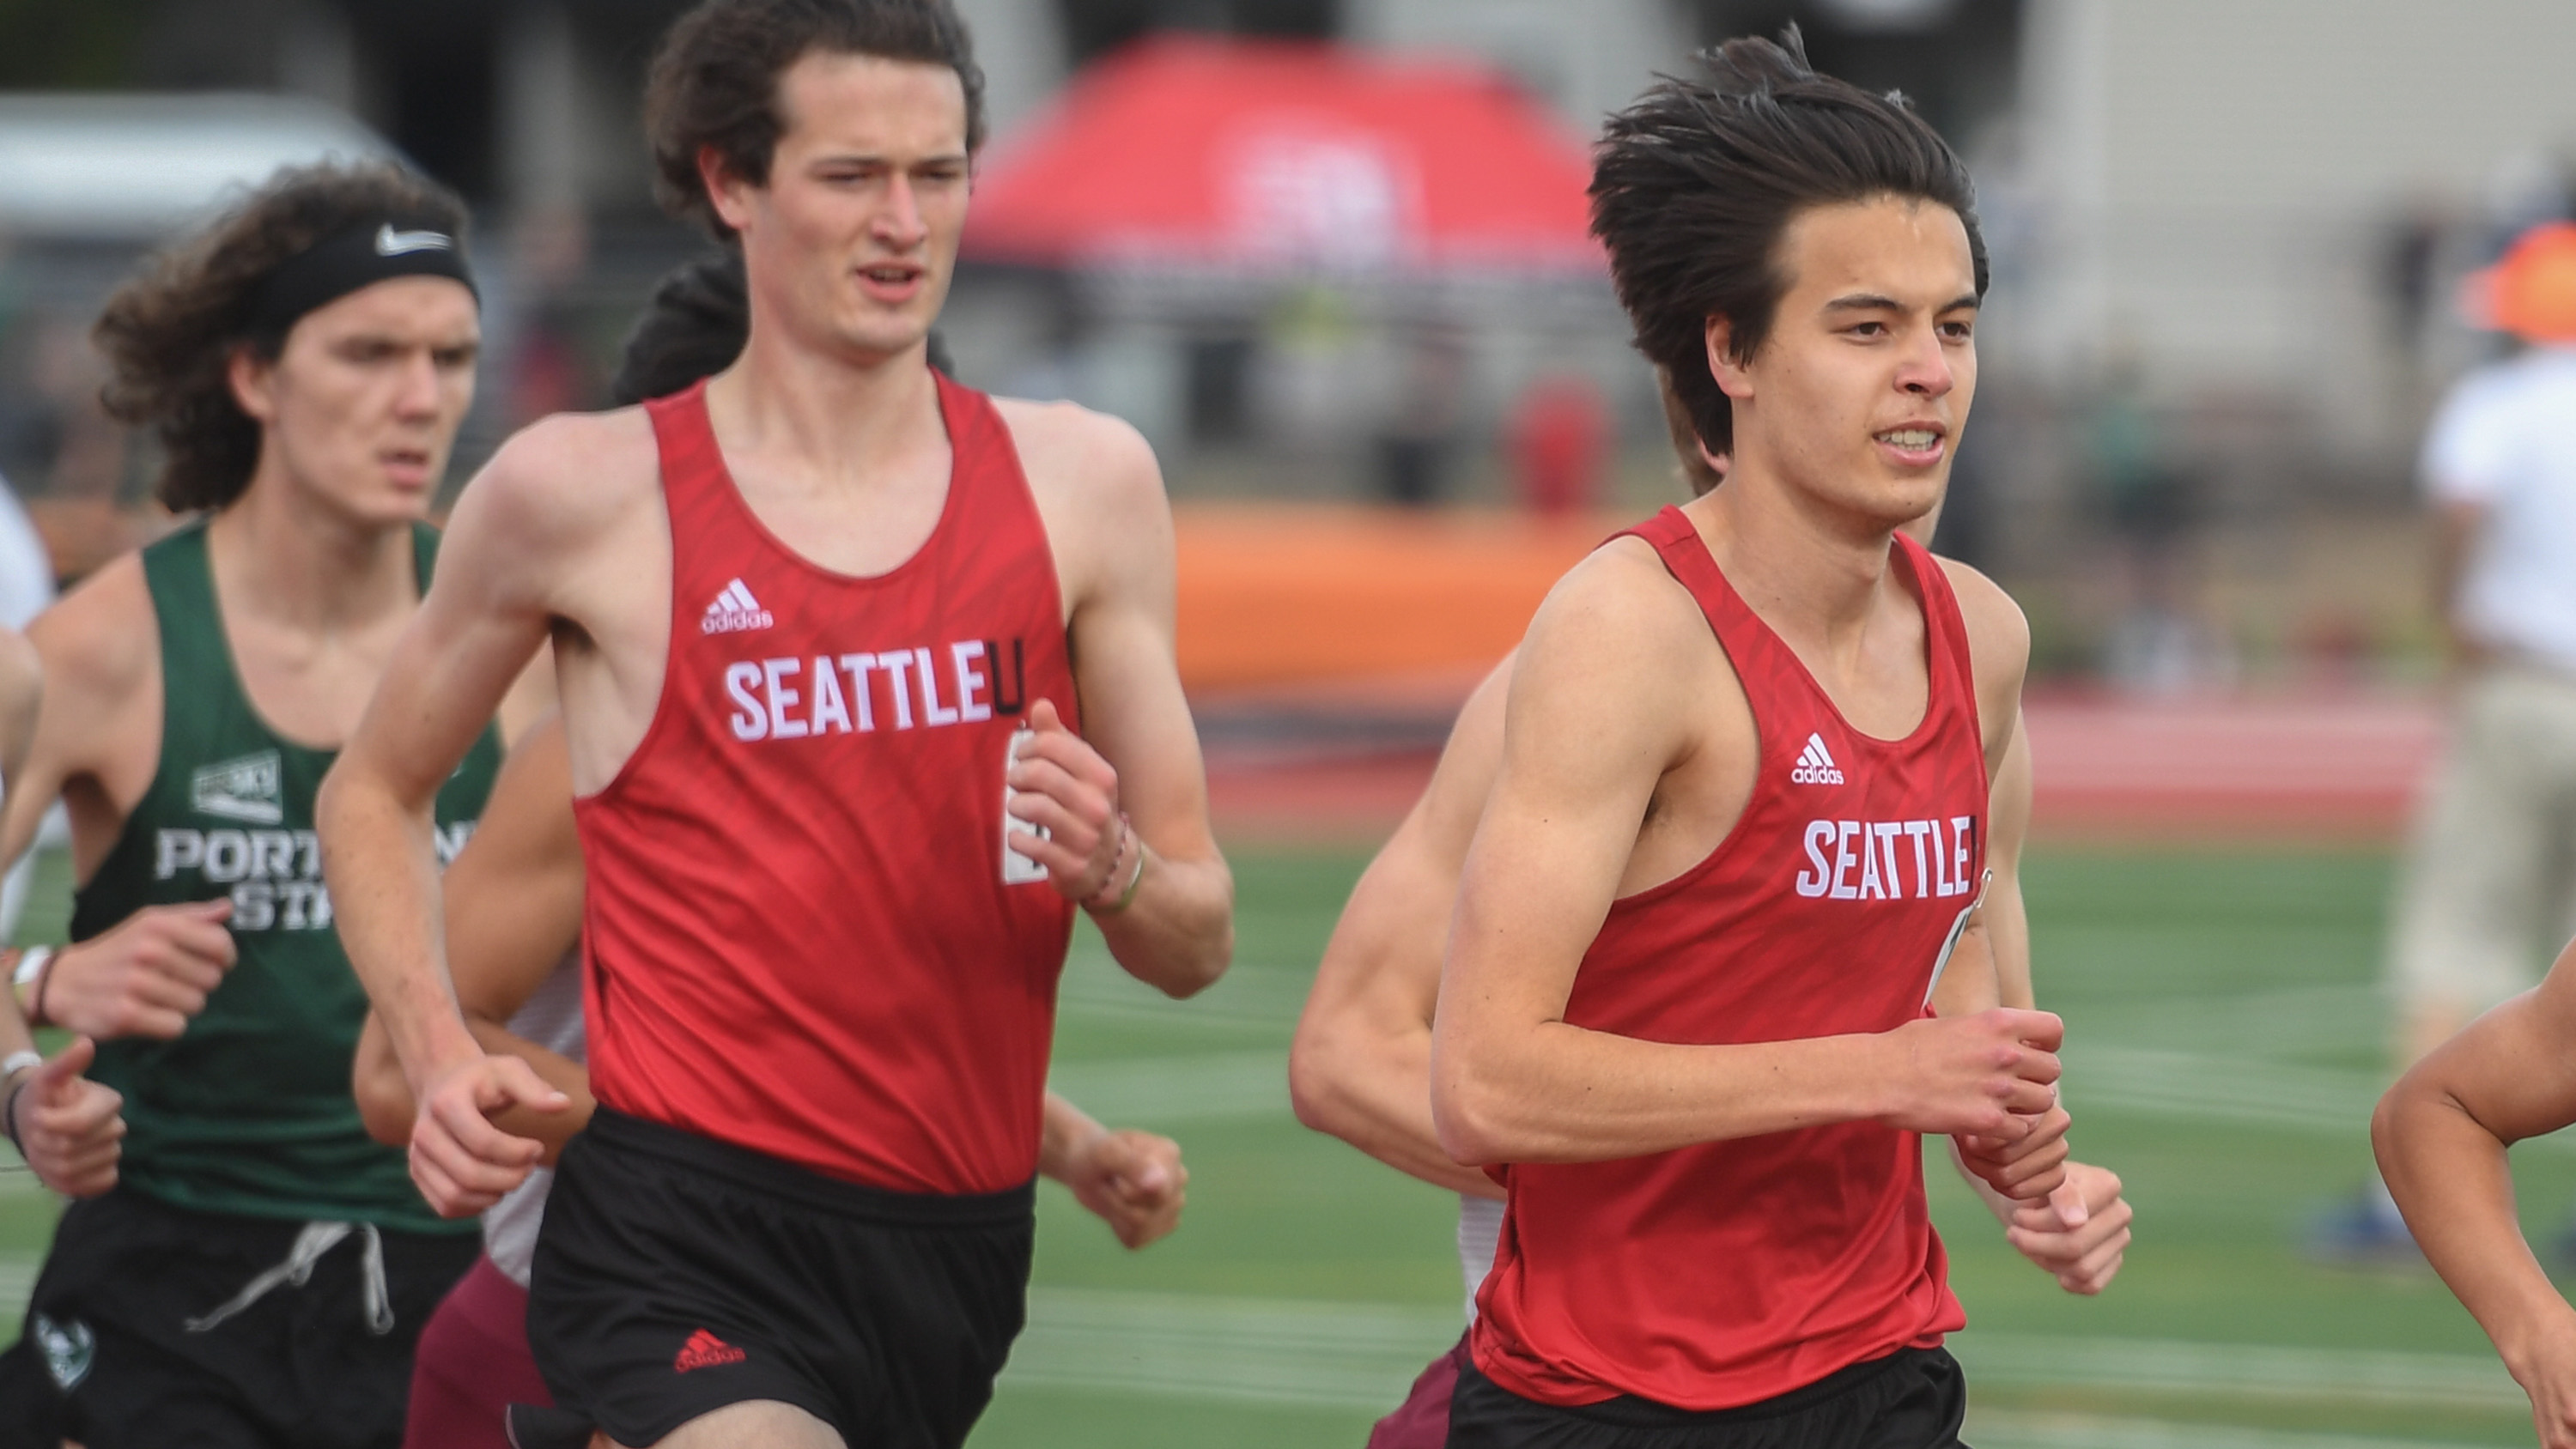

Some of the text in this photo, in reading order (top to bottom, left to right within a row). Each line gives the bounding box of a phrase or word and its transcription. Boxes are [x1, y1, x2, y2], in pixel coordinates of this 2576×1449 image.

[702, 609, 774, 635] adidas
[1791, 765, 1844, 785] adidas
[155, 820, 477, 882] PORTN
[674, 1347, 746, 1373] adidas
